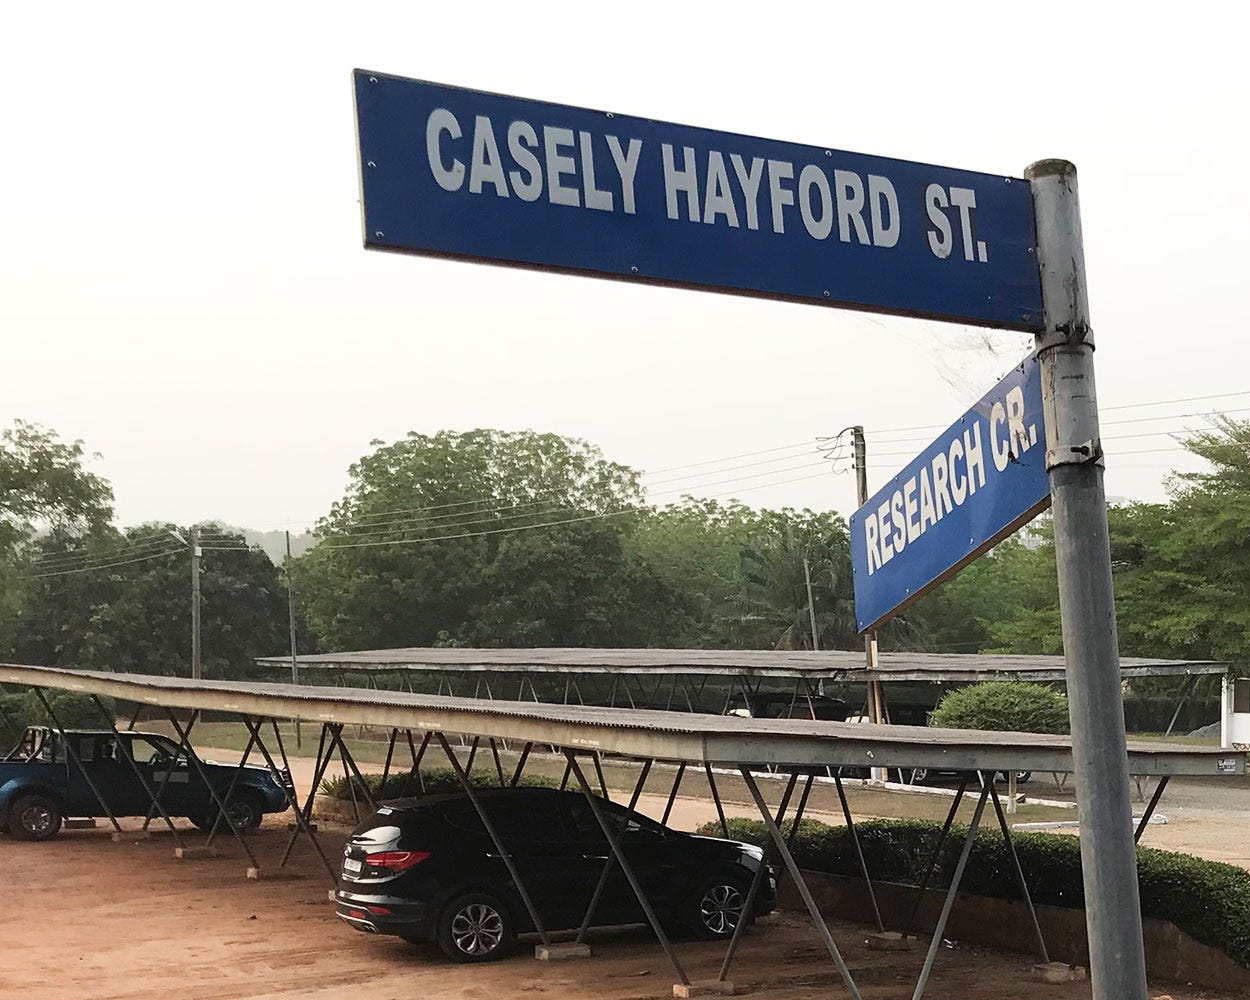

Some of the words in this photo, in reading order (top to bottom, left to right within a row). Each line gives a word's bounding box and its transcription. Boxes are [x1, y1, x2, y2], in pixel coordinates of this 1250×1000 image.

[426, 108, 643, 215] CASELY
[661, 143, 901, 249] HAYFORD
[925, 183, 988, 263] ST.
[864, 420, 986, 576] RESEARCH
[990, 385, 1038, 472] CR.
